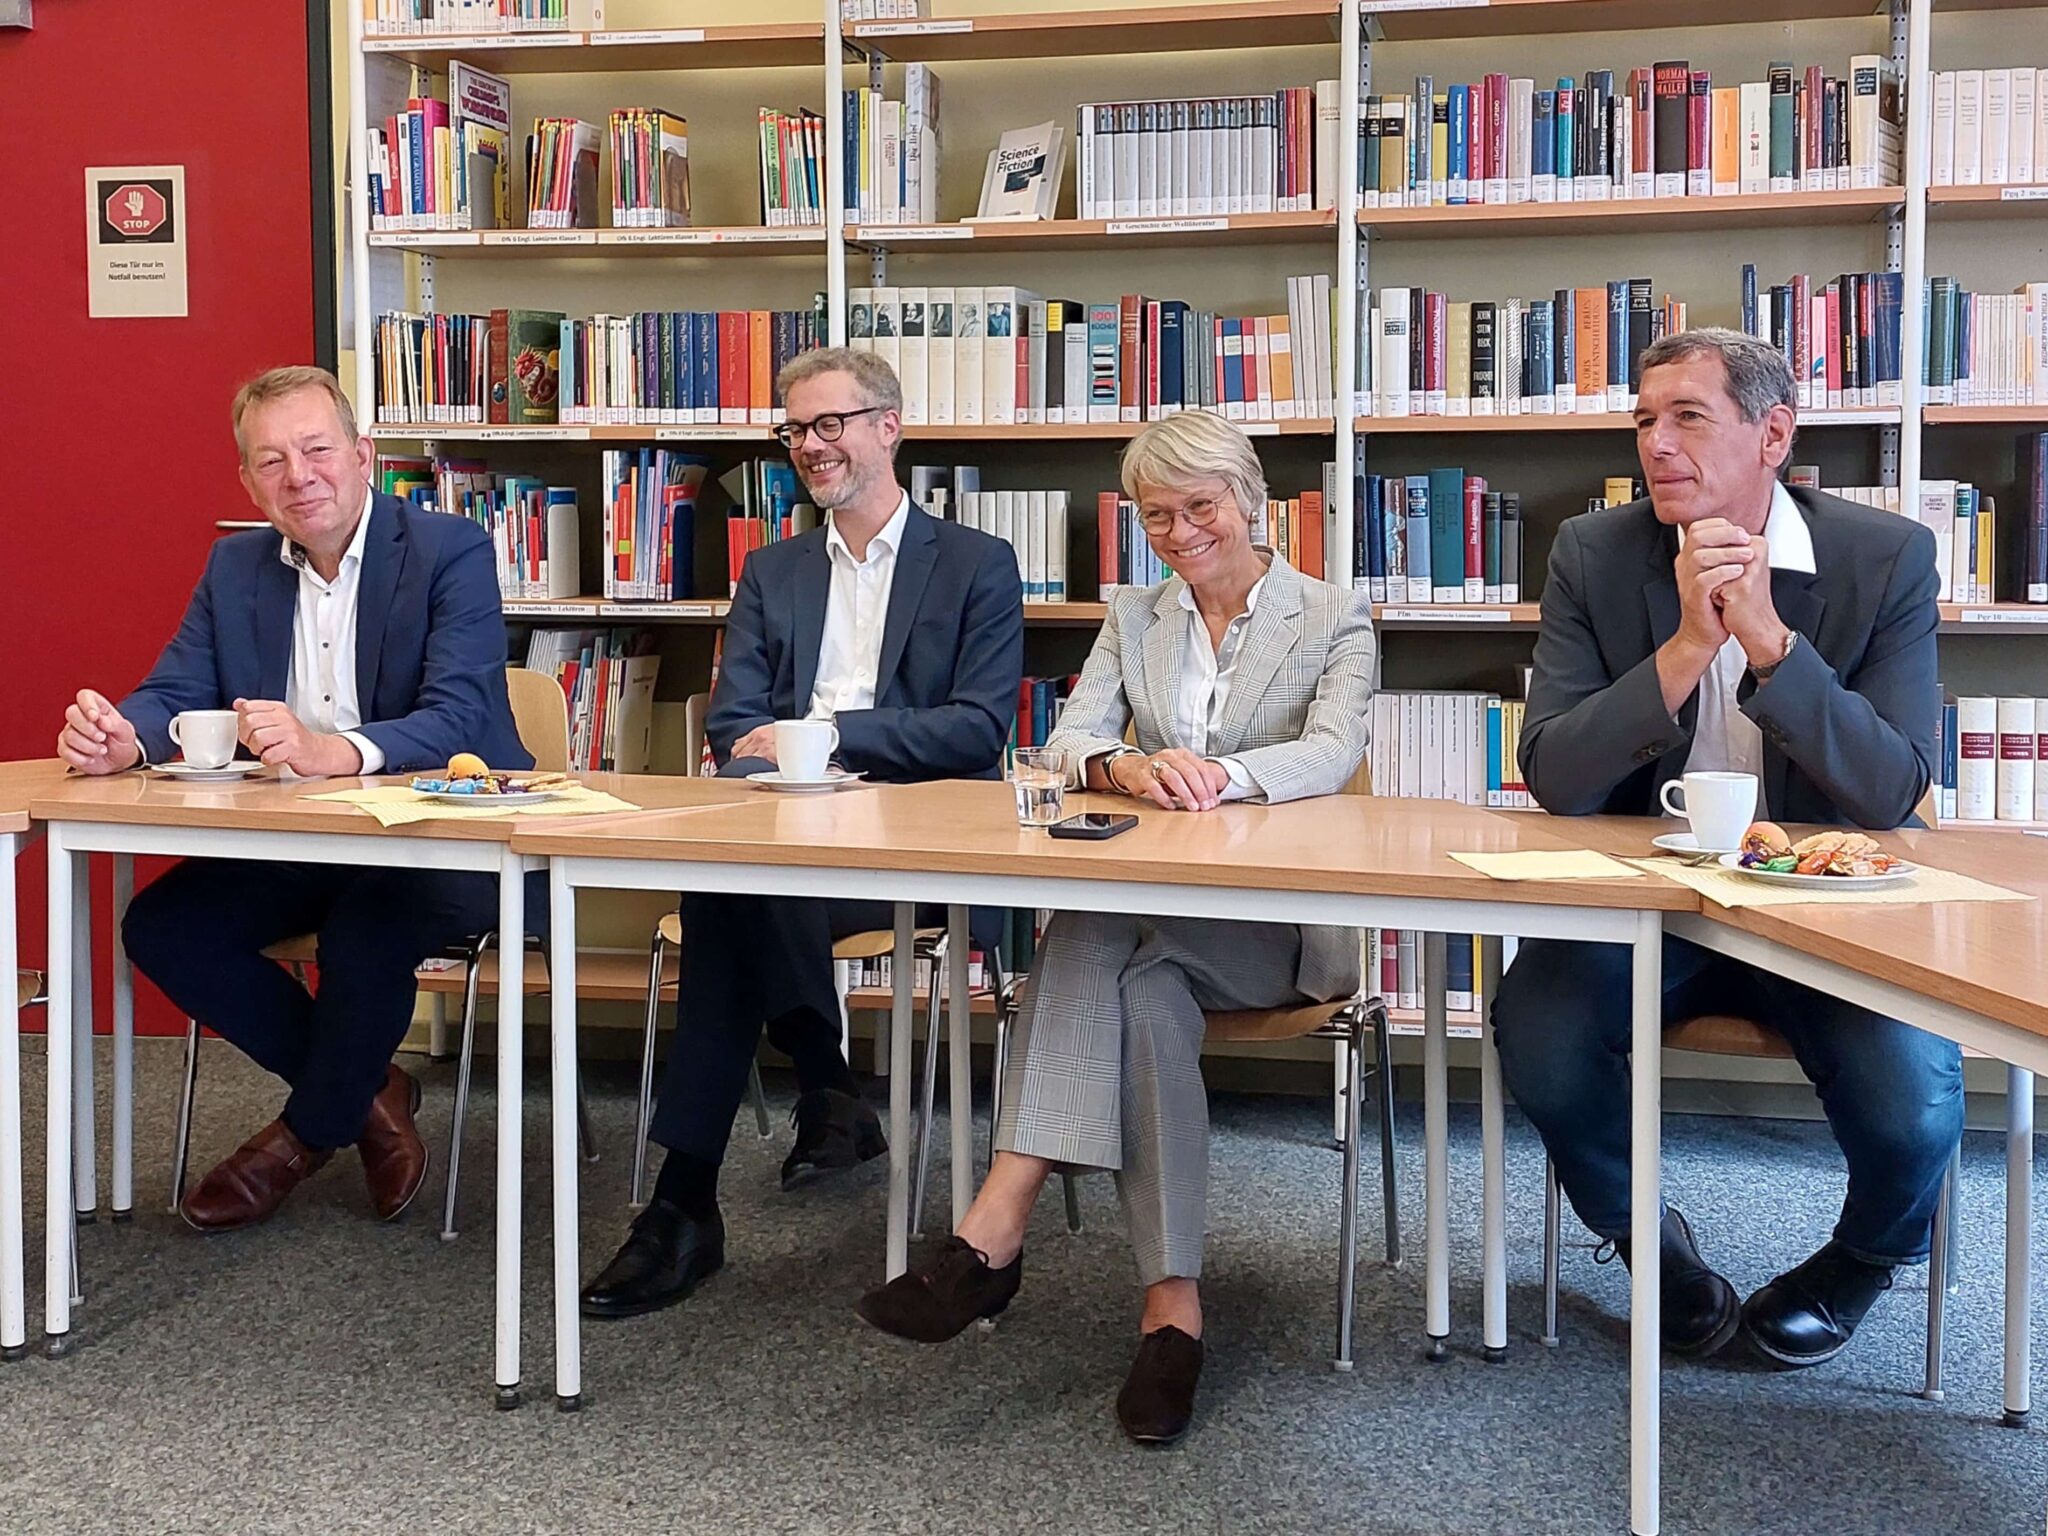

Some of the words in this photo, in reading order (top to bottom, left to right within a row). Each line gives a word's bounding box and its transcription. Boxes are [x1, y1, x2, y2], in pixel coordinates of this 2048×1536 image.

[1656, 82, 1687, 95] MAILER
[1493, 100, 1501, 126] CUPIDO
[1455, 115, 1463, 144] Highsmith
[1472, 115, 1480, 144] Highsmith
[1600, 105, 1608, 151] Feuerprobe
[999, 145, 1040, 162] Science
[1599, 151, 1607, 165] Die
[390, 151, 399, 180] Englisch
[996, 159, 1034, 174] Fiction
[122, 219, 151, 230] STOP
[1125, 222, 1160, 230] Geschichte
[395, 235, 420, 243] Englisch
[109, 261, 128, 269] Diese
[129, 261, 141, 269] Tür
[108, 273, 132, 281] Notfall
[132, 273, 166, 281] benutzen!
[1091, 311, 1117, 320] 1001
[1476, 310, 1492, 320] JOHN
[1583, 298, 1591, 330] BERLIN
[1091, 322, 1117, 330] BÜCHER
[1477, 338, 1492, 348] BECK
[1583, 359, 1591, 379] URIS
[1592, 369, 1601, 388] DER
[1469, 499, 1479, 531] Lügnerin
[1470, 531, 1478, 545] Die
[1369, 941, 1377, 967] Dichter
